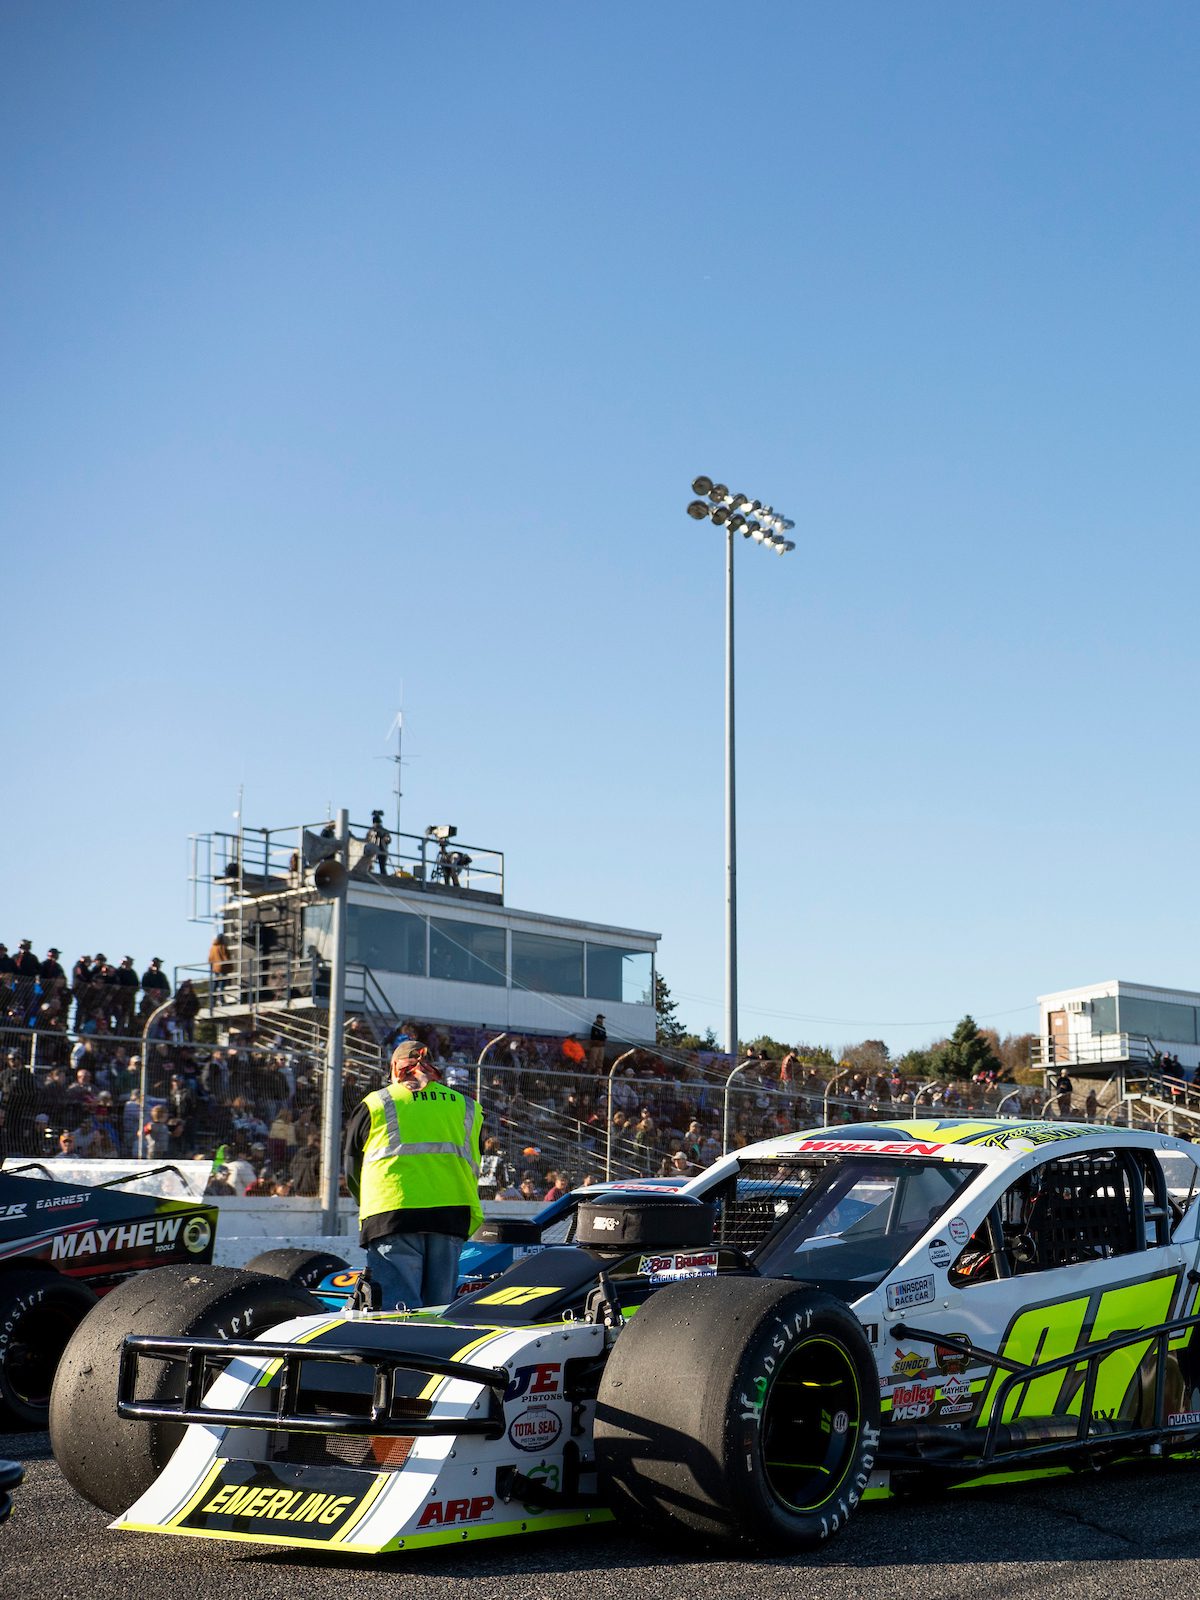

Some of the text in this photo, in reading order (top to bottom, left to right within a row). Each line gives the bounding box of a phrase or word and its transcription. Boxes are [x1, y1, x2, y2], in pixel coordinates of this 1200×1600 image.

[412, 1091, 457, 1102] PHOTO
[798, 1141, 945, 1156] WHELEN
[36, 1192, 92, 1210] EARNEST
[51, 1218, 183, 1261] MAYHEW
[155, 1243, 176, 1253] TOOLS
[651, 1254, 718, 1273] BOB BRUNEAU
[651, 1273, 678, 1283] ENGINE
[902, 1280, 928, 1294] NASCAR
[895, 1291, 929, 1306] RACE CAR
[741, 1308, 814, 1430] Hoosier
[894, 1359, 930, 1372] SUNOCO
[521, 1393, 563, 1403] PISTONS
[892, 1384, 937, 1406] Holley
[940, 1384, 970, 1396] MAYHEW
[891, 1403, 930, 1422] MSD
[514, 1420, 557, 1437] TOTAL SEAL
[201, 1484, 357, 1525] EMERLING
[418, 1495, 495, 1526] ARP
